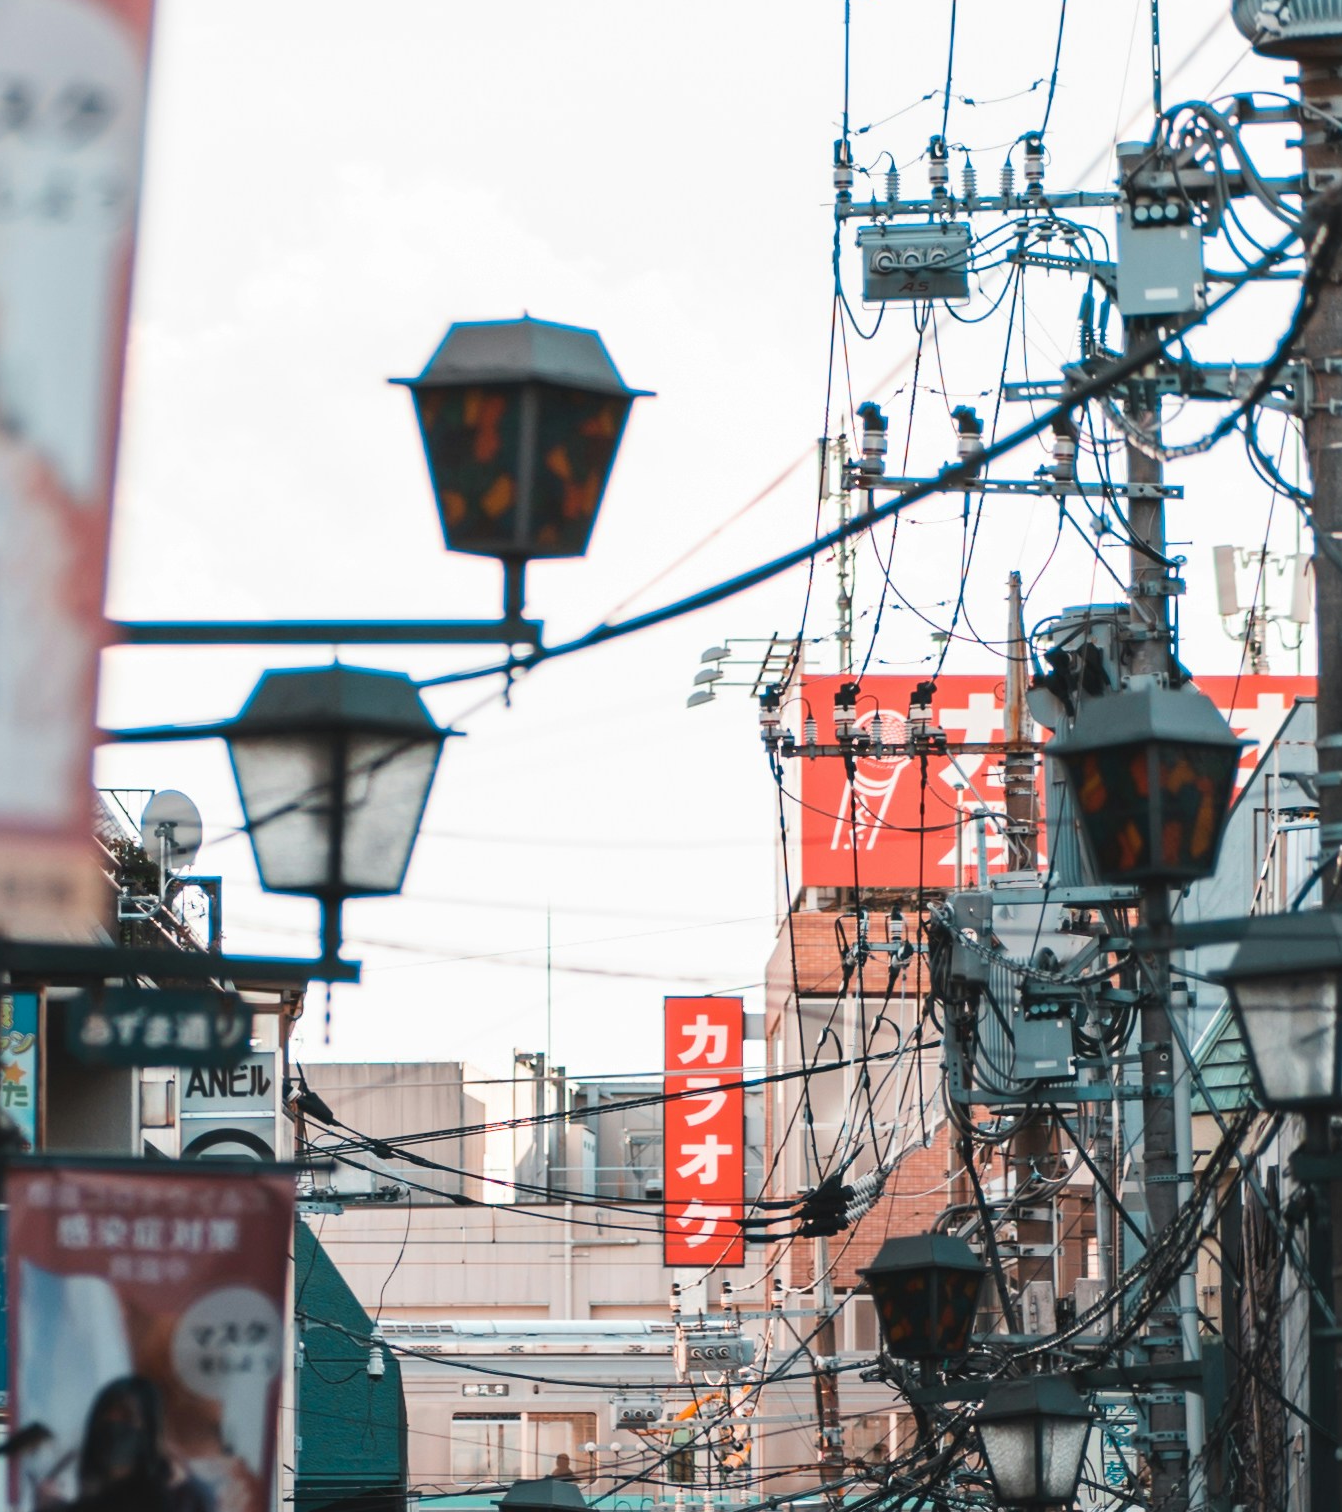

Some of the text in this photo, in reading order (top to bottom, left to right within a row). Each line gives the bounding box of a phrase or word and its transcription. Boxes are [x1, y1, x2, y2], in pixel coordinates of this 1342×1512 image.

[79, 1011, 245, 1050] あずま通り
[185, 1064, 271, 1099] ANビル
[677, 1014, 733, 1247] カラオケ
